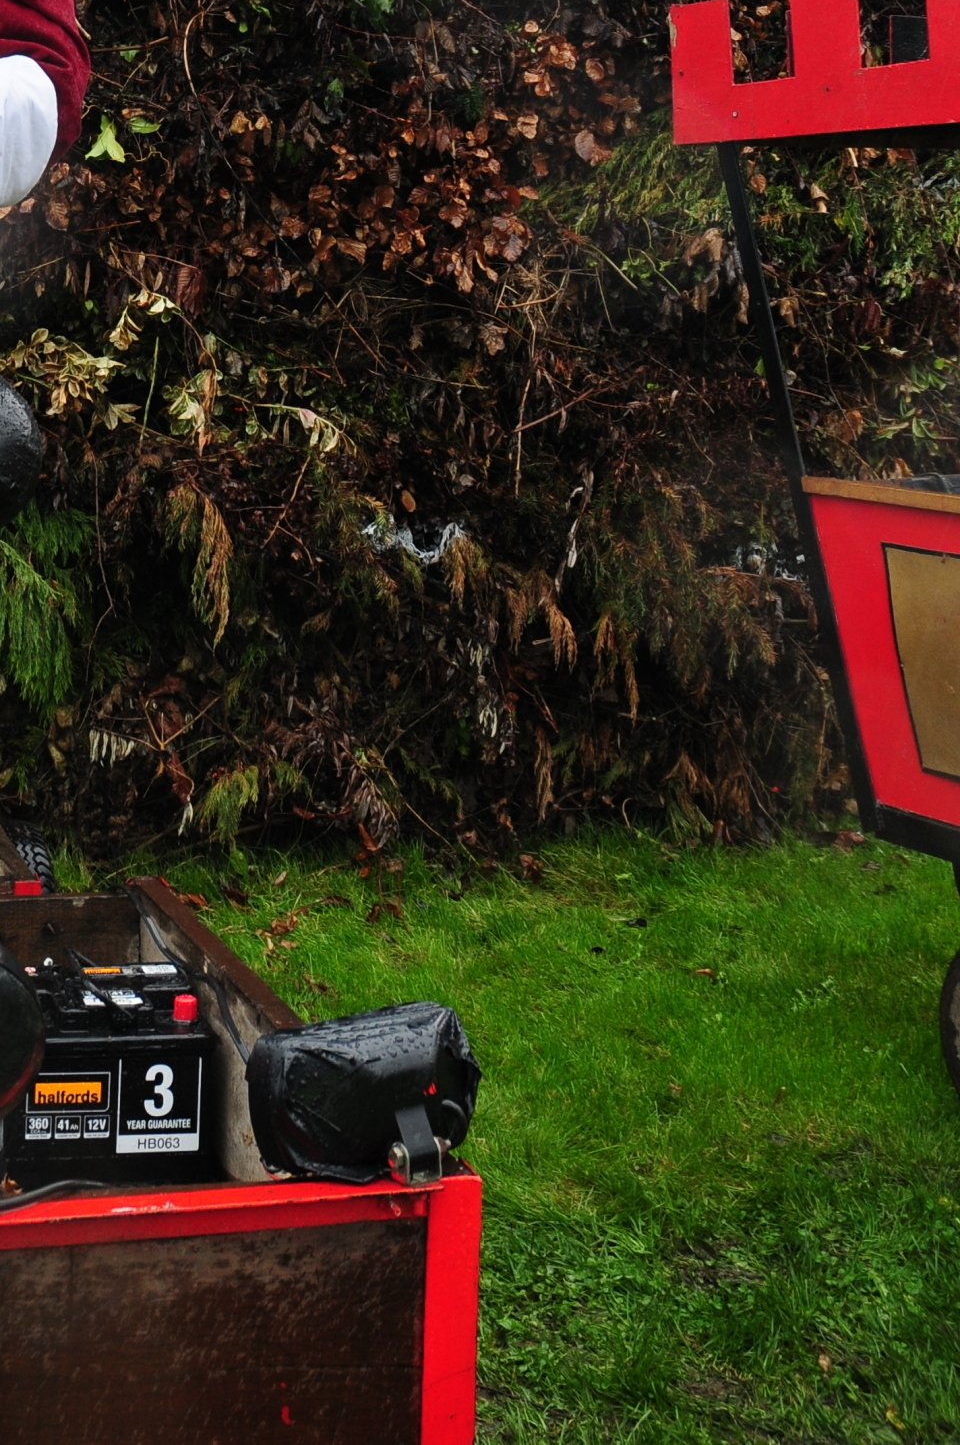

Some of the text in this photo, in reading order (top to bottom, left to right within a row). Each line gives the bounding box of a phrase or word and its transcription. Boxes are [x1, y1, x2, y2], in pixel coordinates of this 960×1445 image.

[38, 1090, 99, 1103] halfords
[144, 1064, 174, 1117] 3
[28, 1118, 49, 1130] 360
[87, 1118, 107, 1131] 12V
[126, 1118, 191, 1130] YEAR GUARANTEE
[137, 1137, 180, 1150] HB063
